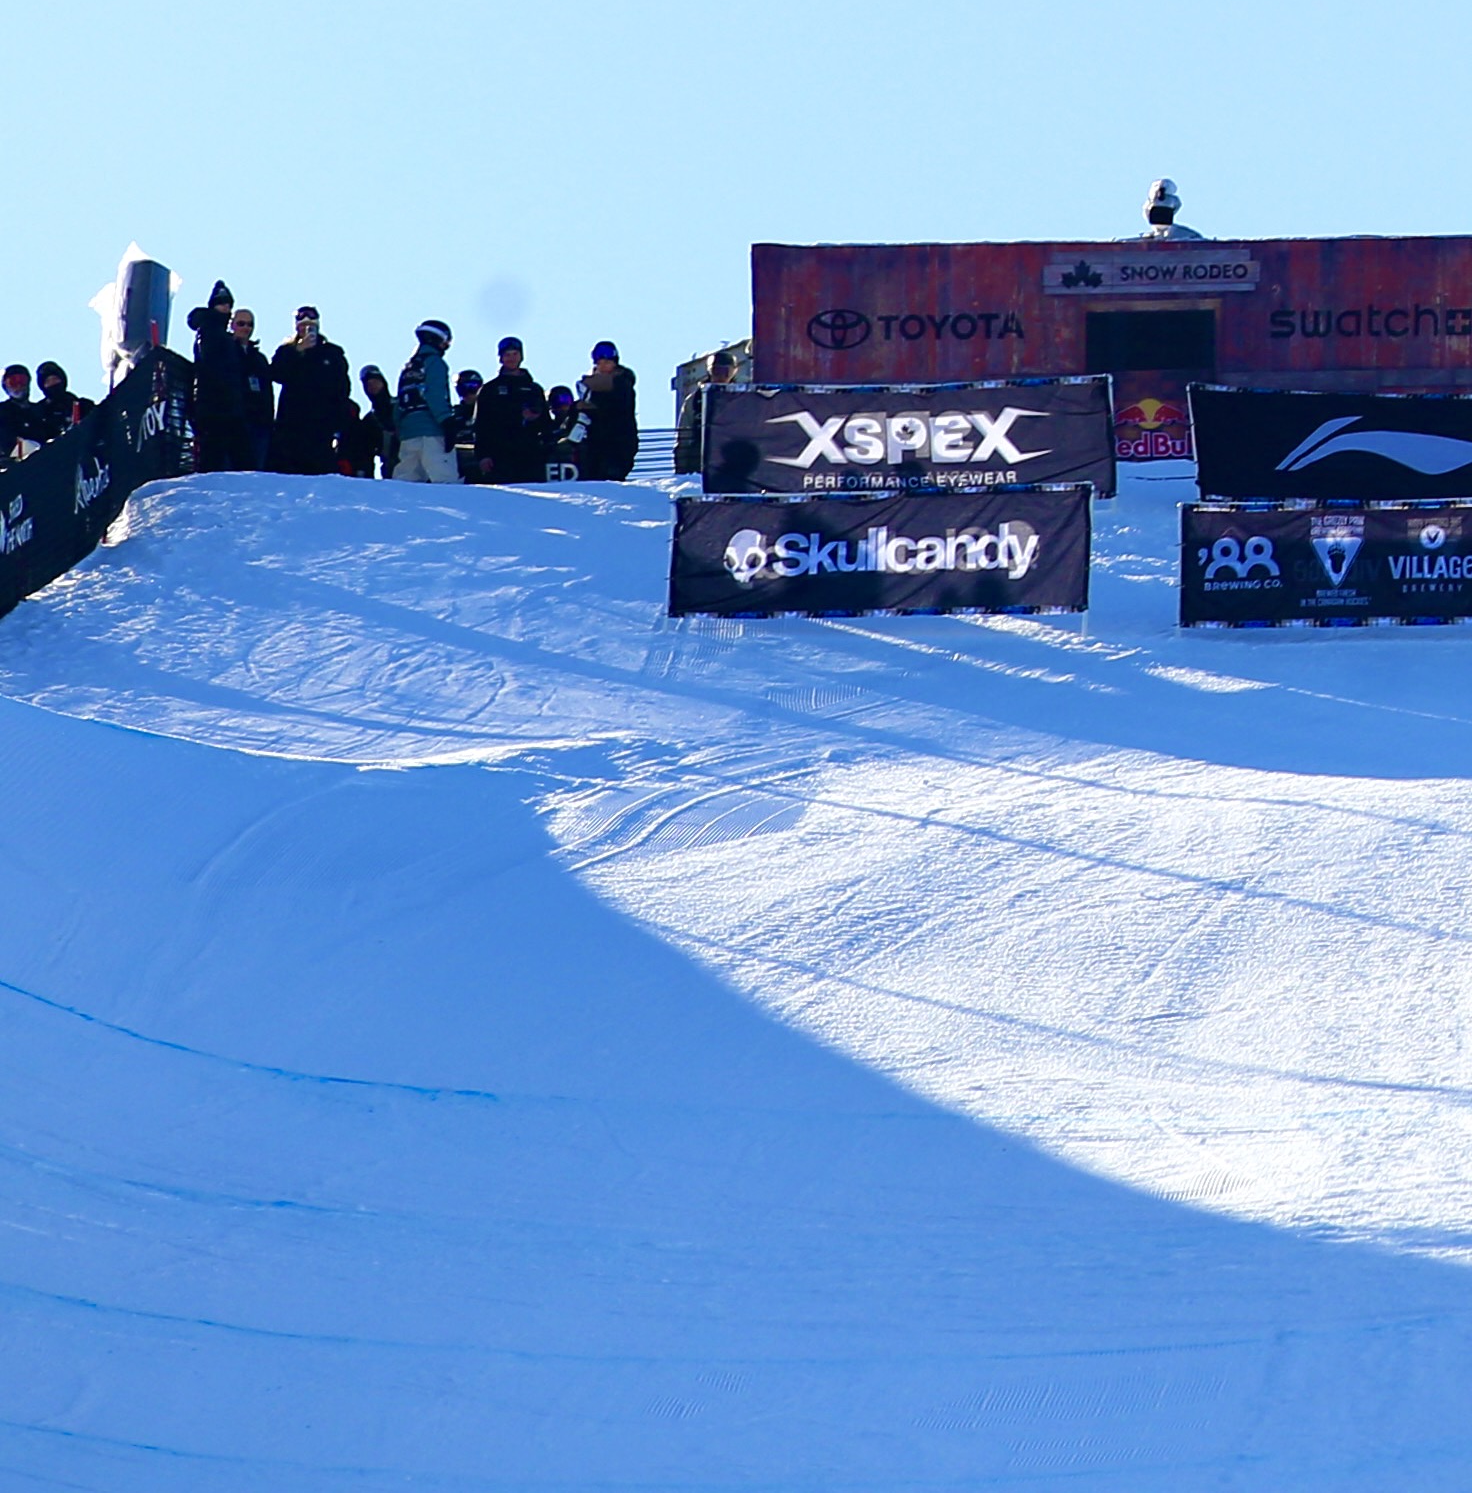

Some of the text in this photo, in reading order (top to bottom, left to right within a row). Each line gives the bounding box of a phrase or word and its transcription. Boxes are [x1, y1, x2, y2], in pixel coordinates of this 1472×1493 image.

[1120, 263, 1249, 283] SNOW RODEO
[877, 313, 1026, 341] TOYOTA
[1270, 305, 1439, 339] swatch
[764, 407, 1054, 469] XSPEX
[803, 471, 1018, 490] PERFORMANCE EYEWEAR
[773, 521, 1040, 580] Skullcandy
